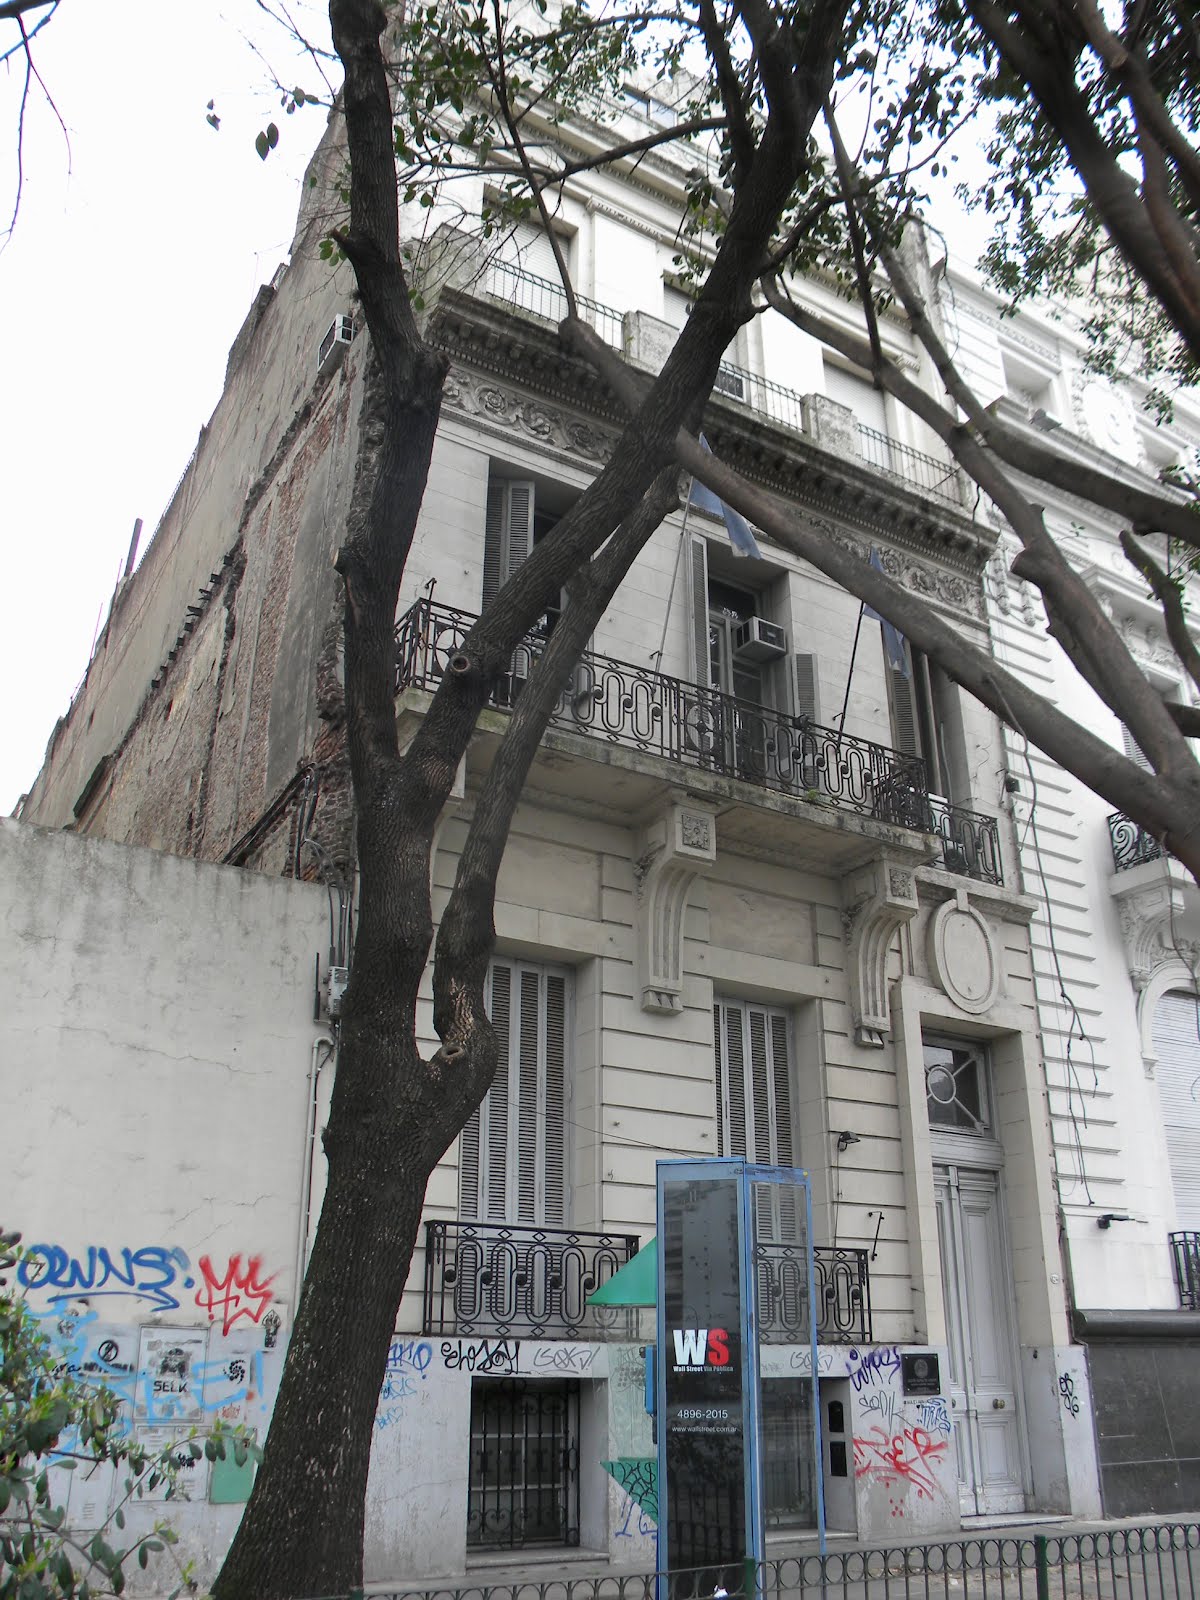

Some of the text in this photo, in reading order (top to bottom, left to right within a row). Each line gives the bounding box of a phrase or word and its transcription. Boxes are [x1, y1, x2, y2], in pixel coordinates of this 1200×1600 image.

[673, 1328, 729, 1366] WS
[153, 1380, 189, 1394] SELK
[677, 1409, 729, 1419] 4896-2015
